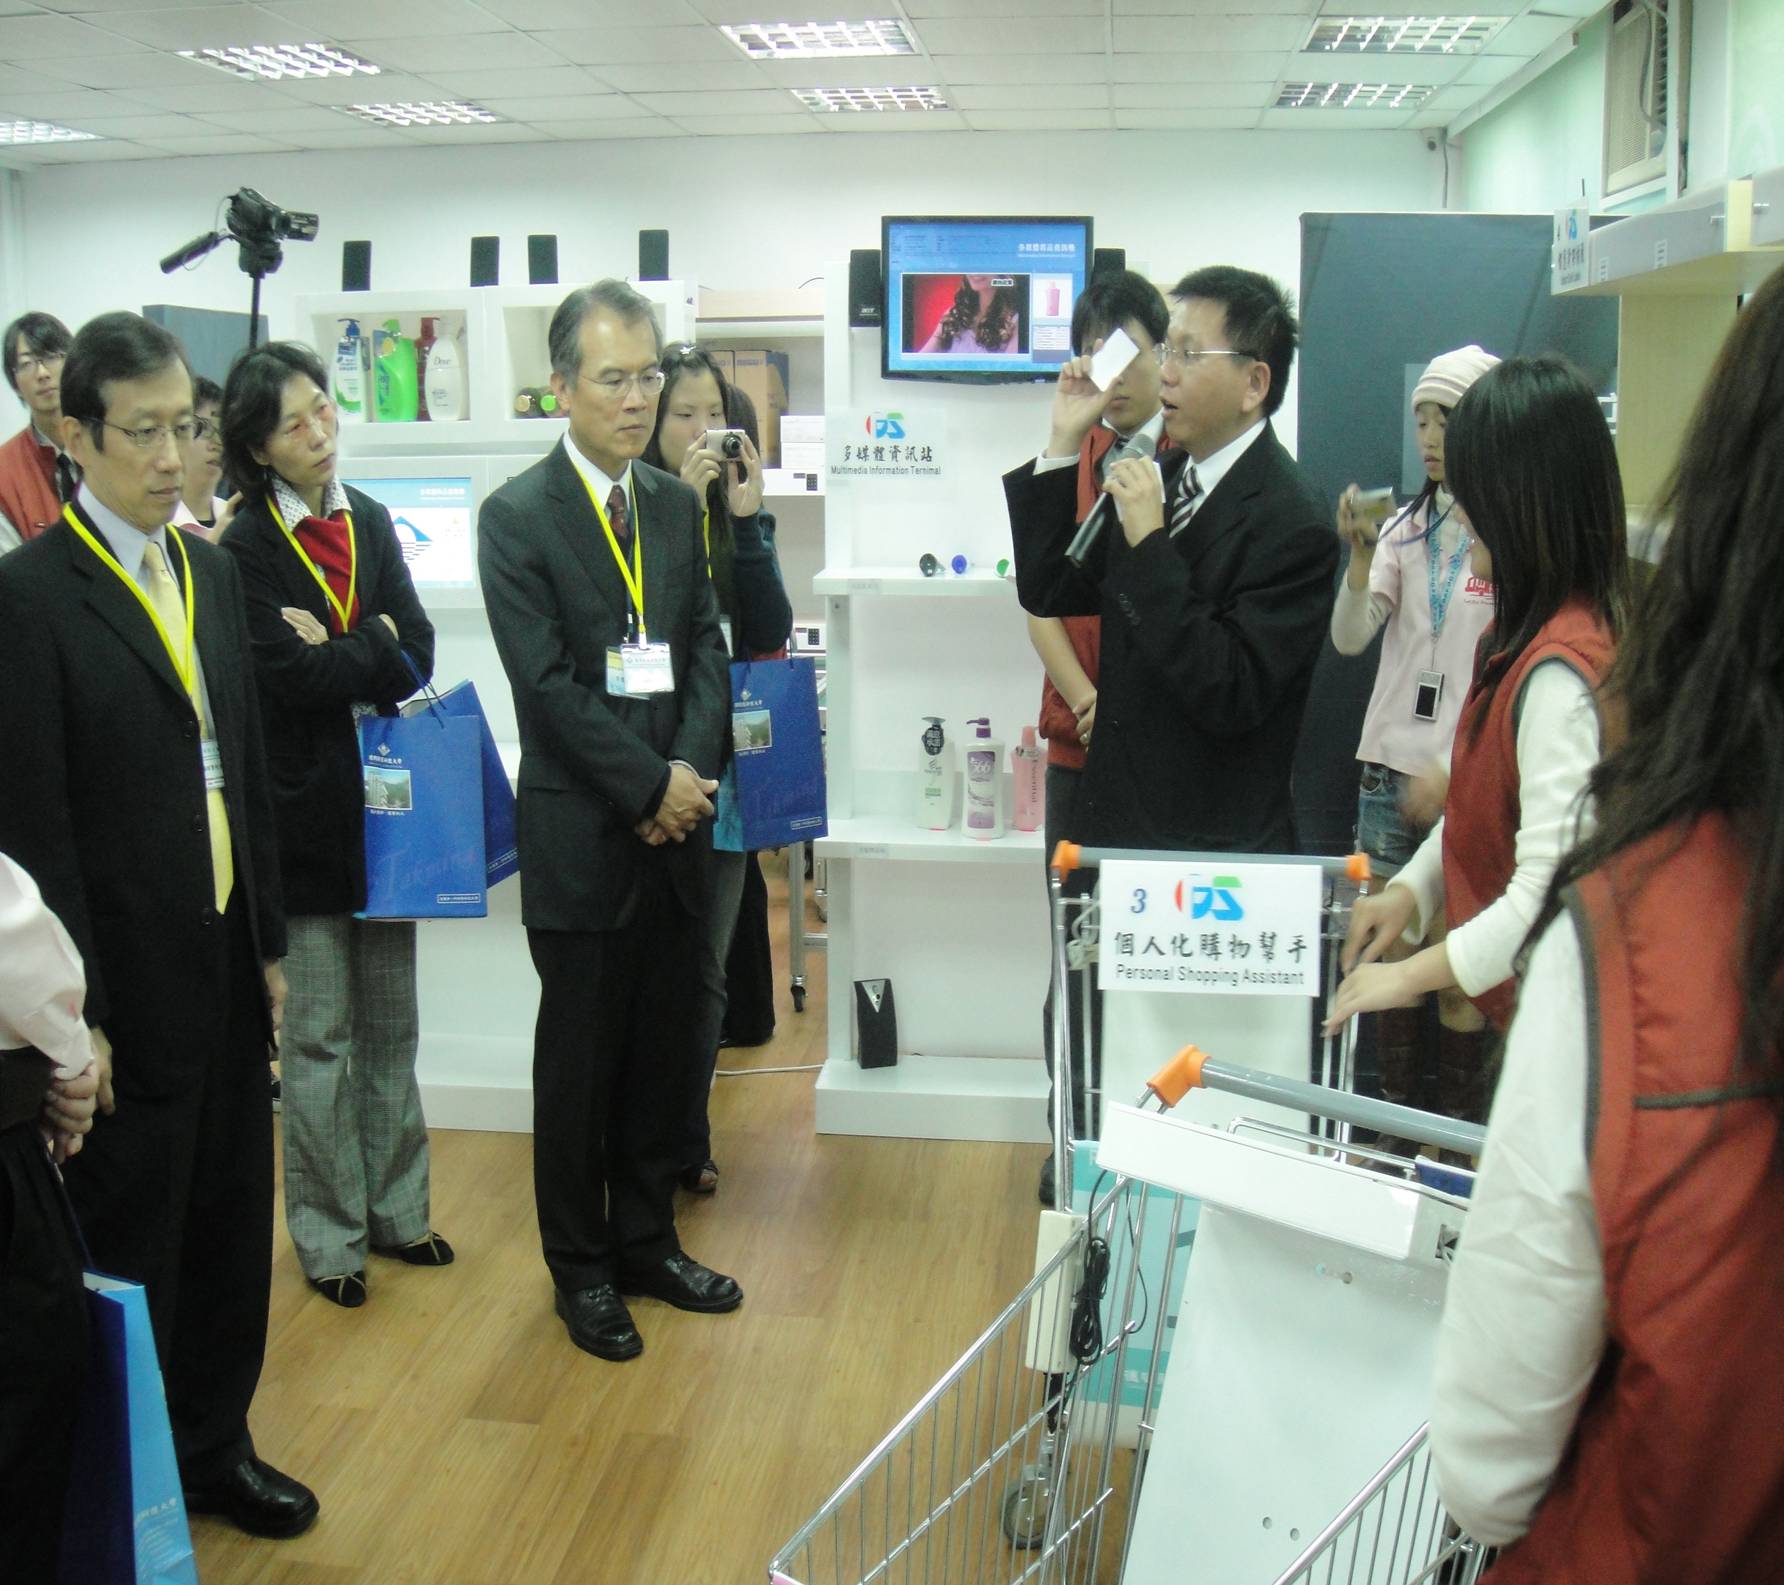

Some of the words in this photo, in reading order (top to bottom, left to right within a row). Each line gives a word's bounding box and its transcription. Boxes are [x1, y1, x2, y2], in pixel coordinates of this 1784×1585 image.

[843, 444, 933, 462] 多媒體資訊站
[831, 465, 868, 475] Multimedia
[869, 465, 909, 475] Information
[1131, 888, 1147, 913] 3
[1117, 963, 1174, 980] Personal
[1178, 966, 1239, 986] Shopping
[1242, 968, 1304, 984] Assistant
